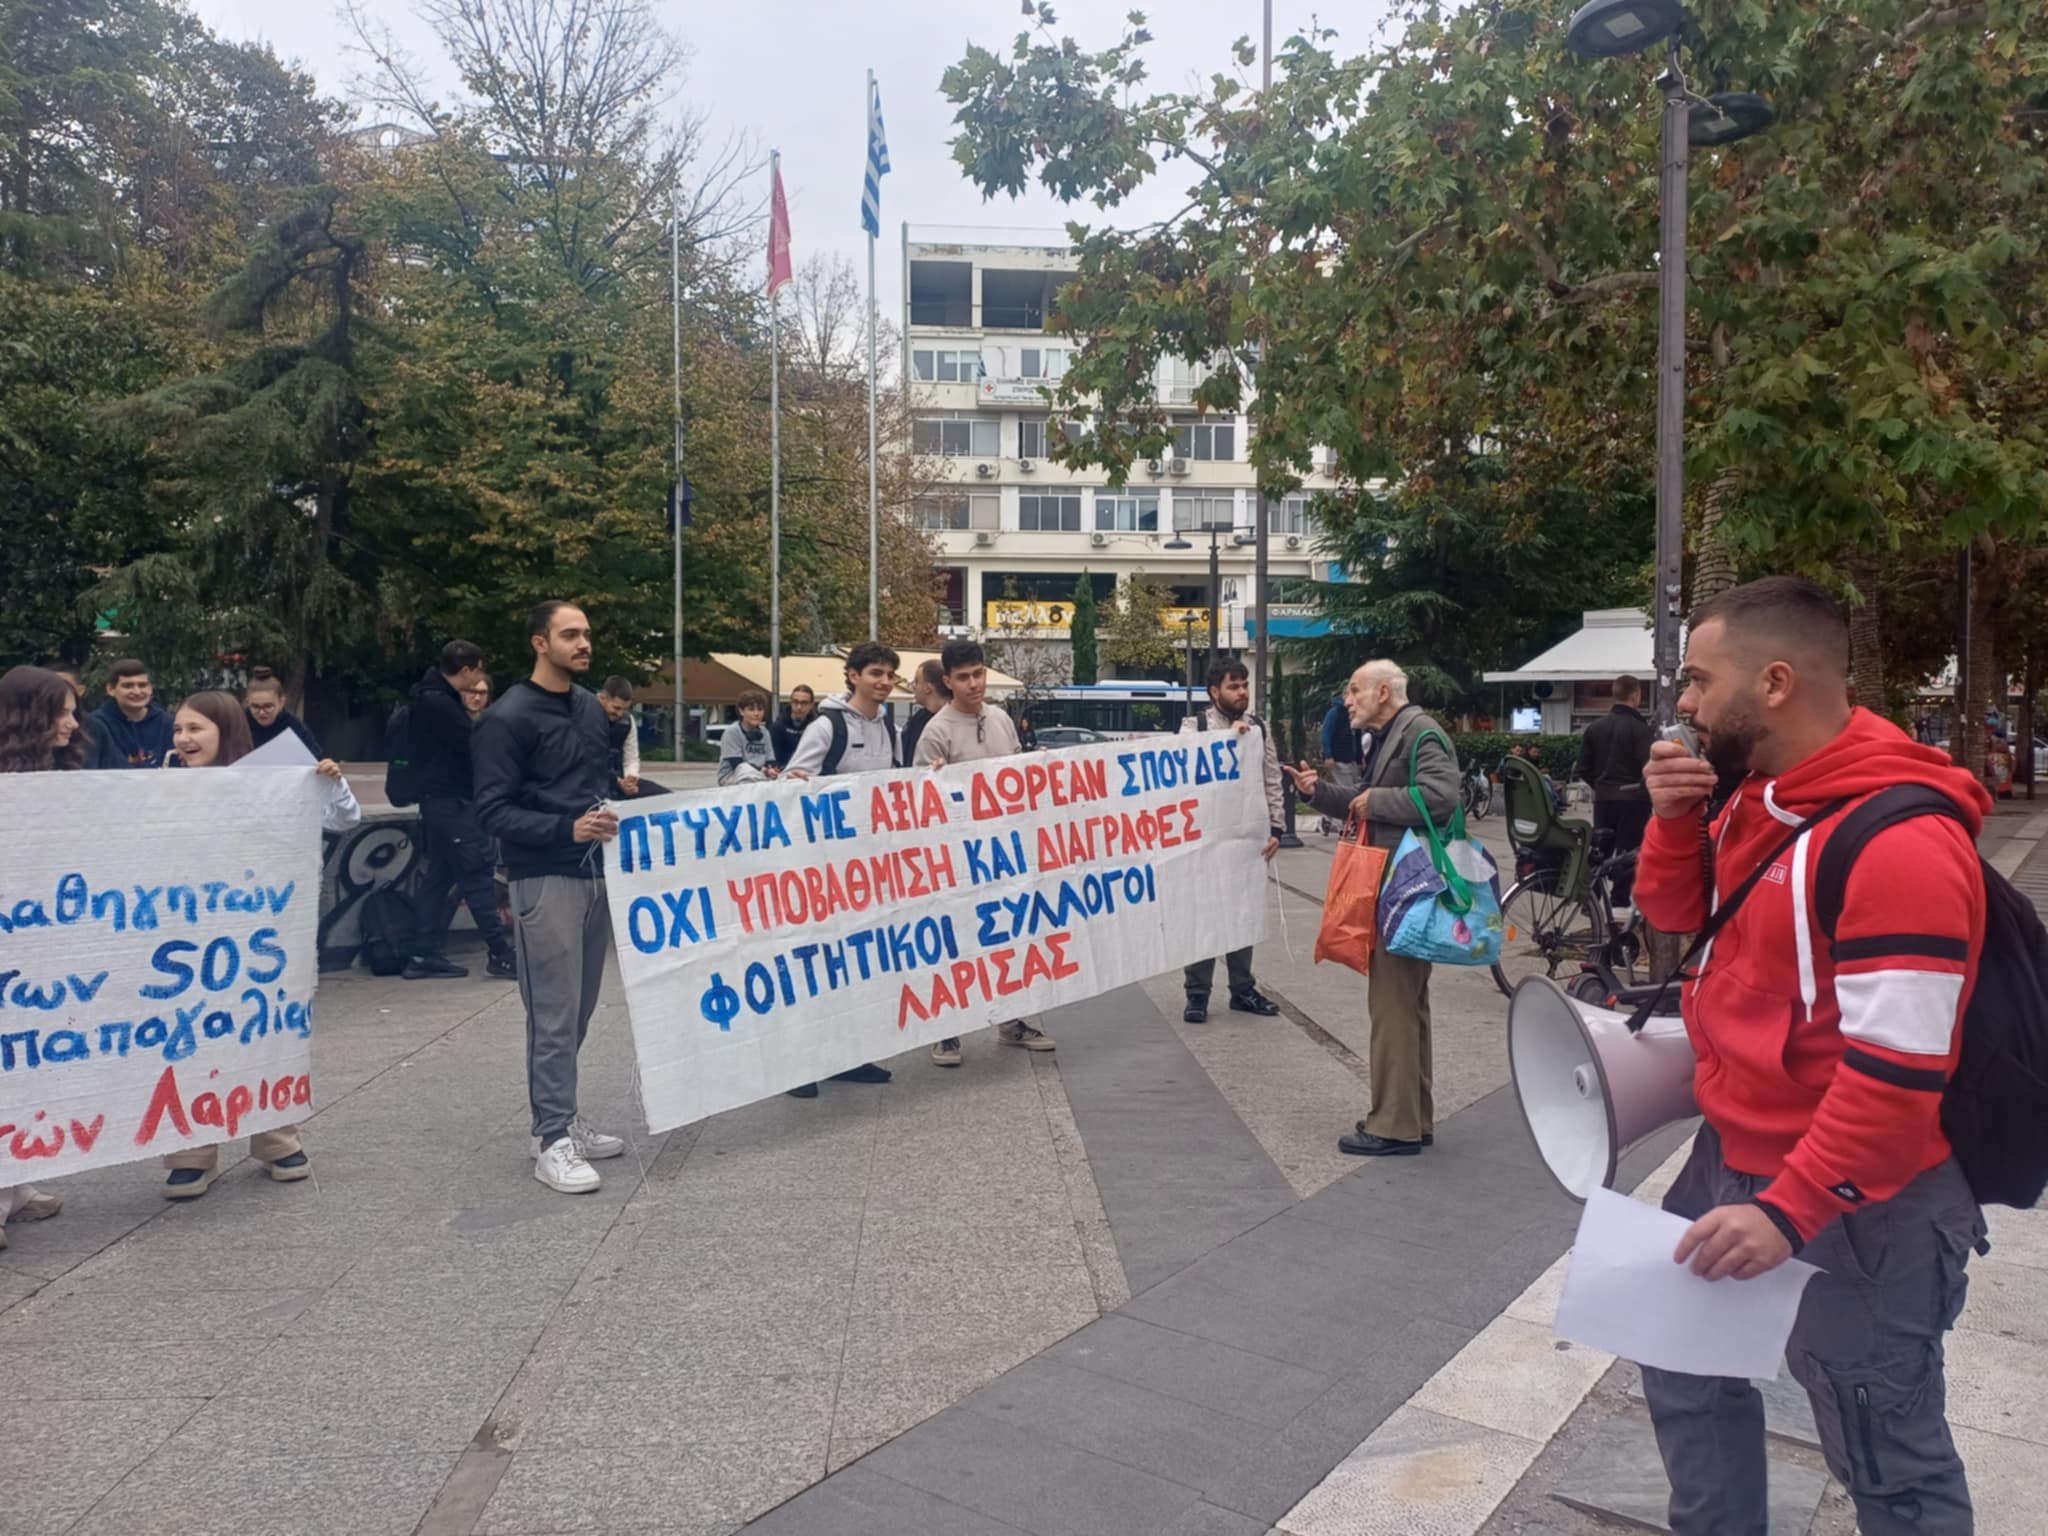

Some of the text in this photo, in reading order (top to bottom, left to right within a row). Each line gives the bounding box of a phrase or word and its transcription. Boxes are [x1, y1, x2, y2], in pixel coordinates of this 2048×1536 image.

[618, 800, 792, 873] ΠΤΥΧΙΑ
[799, 790, 857, 843] ΜΕ
[1118, 738, 1240, 797] ΣΠΟΥΔΕΣ
[628, 799, 1202, 955] ΟΧΙ ΥΠΟΒΑΘΜΙΣΗ ΚΑΙ ΔΙΑΓΡΑΦΕΣ
[138, 927, 288, 1000] SOS
[699, 863, 1157, 1032] ΦΟΙΤΗΤΙΚΟΙ ΣΥΛΛΟΓΟΙ
[897, 932, 1080, 1030] ΛΑΡΙΣΑΣ
